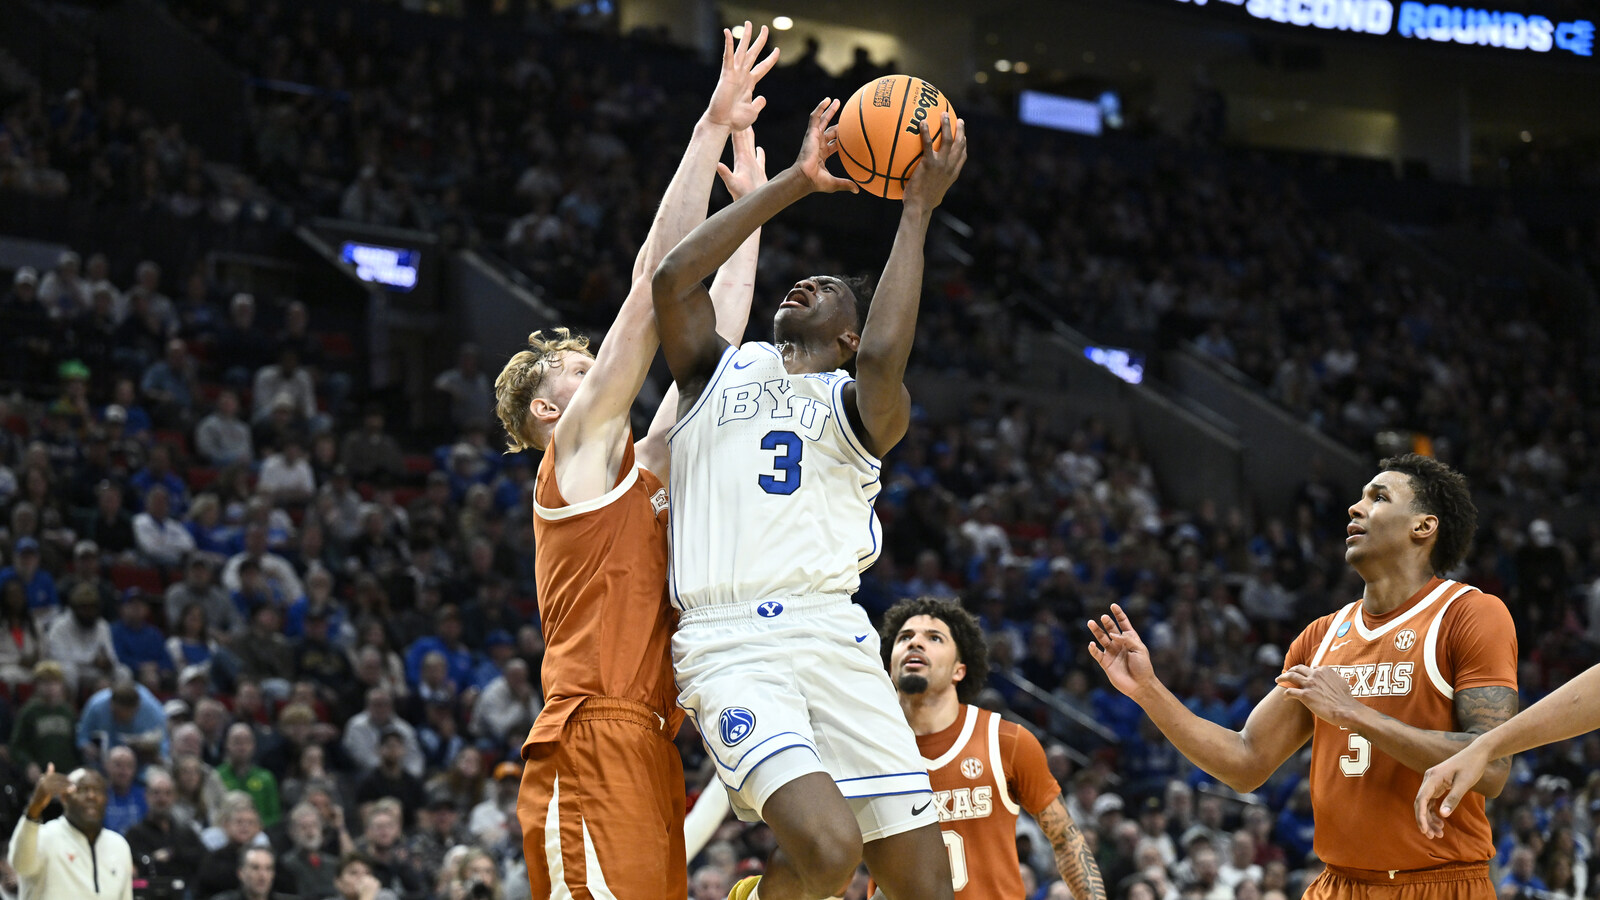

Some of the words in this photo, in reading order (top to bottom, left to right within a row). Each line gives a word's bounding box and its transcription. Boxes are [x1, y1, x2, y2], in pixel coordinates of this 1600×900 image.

[1398, 1, 1554, 52] ROUNDS
[718, 379, 832, 441] BYU
[758, 430, 804, 496] 3
[1395, 631, 1415, 650] SEC
[962, 758, 983, 778] SEC
